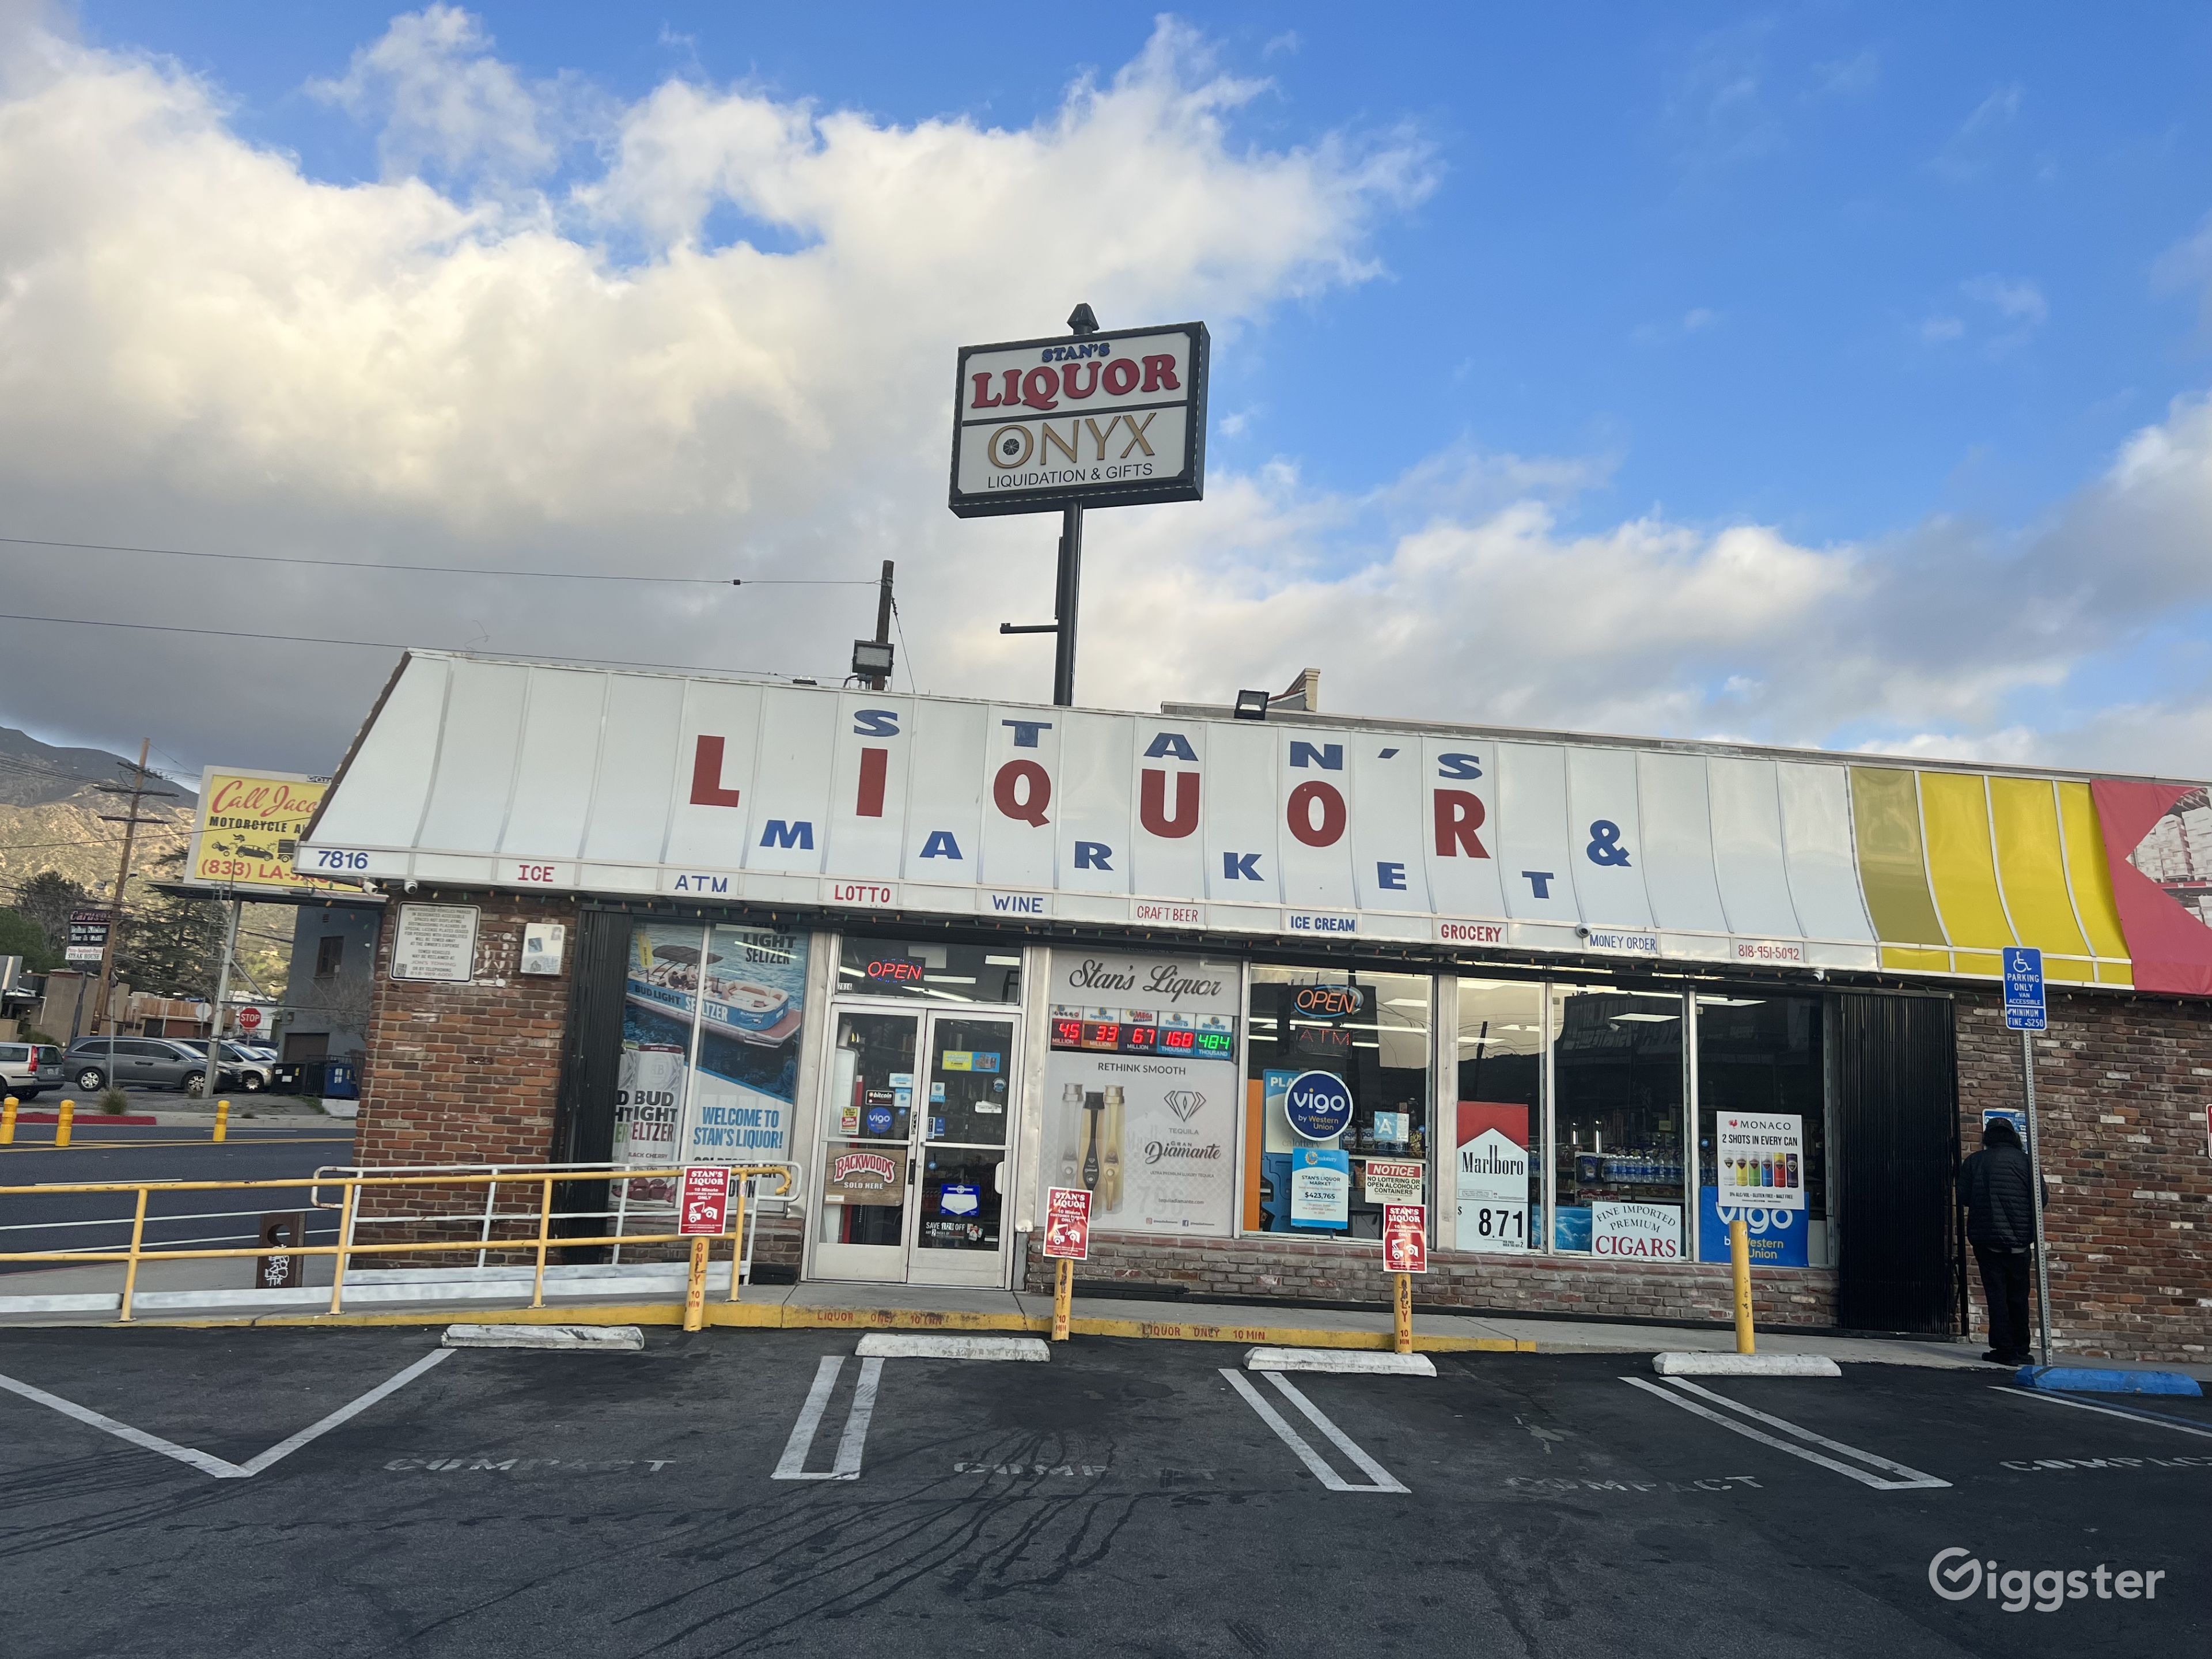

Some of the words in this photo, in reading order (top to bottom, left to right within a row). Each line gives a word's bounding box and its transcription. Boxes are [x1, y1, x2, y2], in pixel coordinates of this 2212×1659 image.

[1041, 343, 1110, 362] STAN'S
[971, 354, 1180, 410] LIQUOR
[988, 412, 1157, 468] ONYX
[988, 469, 1086, 488] LIQUIDATION
[1091, 468, 1101, 480] &
[1106, 463, 1153, 479] GIFTS
[212, 780, 270, 813] Call
[690, 735, 1491, 858] LIQUOR
[1586, 820, 1632, 866] &
[210, 816, 287, 832] MOTORCYCLE
[319, 851, 368, 869] 7816
[759, 820, 1554, 900] MARKET
[202, 859, 251, 878] (833)
[517, 865, 554, 882] ICE
[675, 874, 728, 893] ATM
[834, 884, 891, 903] LOTTO
[993, 895, 1043, 913] WINE
[1137, 906, 1170, 921] CRAFT
[1172, 907, 1199, 923] BEER
[1290, 915, 1312, 930] ICE
[1314, 916, 1355, 932] CREAM
[1441, 923, 1502, 942] GROCERY
[744, 933, 797, 949] LIGHT
[1590, 934, 1623, 949] MONEY
[1626, 936, 1656, 950] ORDER
[745, 948, 790, 964] SELTZER
[1738, 944, 1800, 960] 818-951-5092
[868, 961, 922, 980] OPEN
[2008, 973, 2039, 983] PARKING
[1069, 959, 1135, 990] Stan's
[1143, 965, 1221, 1002] Liquor
[2014, 983, 2033, 991] ONLY
[635, 984, 652, 996] BUD
[654, 990, 681, 1005] LIGHT
[1297, 989, 1355, 1013] OPEN
[241, 1014, 260, 1022] STOP
[2012, 1009, 2039, 1017] MINIMUM
[1059, 1023, 1080, 1039] 45
[1096, 1025, 1118, 1041] 33
[1132, 1028, 1156, 1044] 67
[1166, 1031, 1194, 1047] 168
[1300, 1029, 1350, 1045] ATM
[1198, 1034, 1230, 1050] 484
[1098, 1062, 1140, 1073] RETHINK
[1143, 1065, 1185, 1075] SMOOTH
[634, 1090, 674, 1106] BUD
[1293, 1088, 1345, 1114] vigo
[703, 1107, 762, 1127] WELCOME
[764, 1110, 779, 1128] TO
[869, 1112, 890, 1123] vigo
[1298, 1115, 1307, 1123] by
[1309, 1115, 1338, 1124] Western
[1741, 1120, 1791, 1130] MONACO
[632, 1122, 674, 1142] ELTZER
[1378, 1118, 1392, 1134] A
[694, 1127, 733, 1146] STAN'S
[736, 1130, 783, 1149] LIQUOR!
[1722, 1134, 1727, 1143] 2
[1729, 1134, 1750, 1144] SHOTS
[1752, 1135, 1759, 1144] IN
[1761, 1136, 1782, 1145] EVERY
[1784, 1137, 1798, 1146] CAN
[1145, 1141, 1221, 1164] Diamante
[1462, 1145, 1523, 1175] Marlboro
[835, 1154, 896, 1183] BACKWOODS
[1373, 1165, 1415, 1176] NOTICE
[1054, 1199, 1085, 1209] LIQUOR
[1055, 1192, 1085, 1201] STAN'S
[1389, 1214, 1421, 1223] LIQUOR
[1457, 1206, 1462, 1215] $
[1479, 1208, 1522, 1238] 8.71
[1597, 1207, 1620, 1222] FINE
[1623, 1205, 1676, 1226] IMPORTED
[1610, 1219, 1660, 1233] PREMIUM
[1596, 1236, 1676, 1257] CIGARS
[1749, 1248, 1777, 1259] Union
[695, 1243, 704, 1285] ONLY
[817, 1312, 854, 1321] LIQUOR
[910, 1315, 920, 1324] 10
[1059, 1315, 1066, 1323] 10
[1193, 1325, 1220, 1338] ONLY
[1233, 1330, 1243, 1339] 10
[1247, 1331, 1266, 1340] MIN
